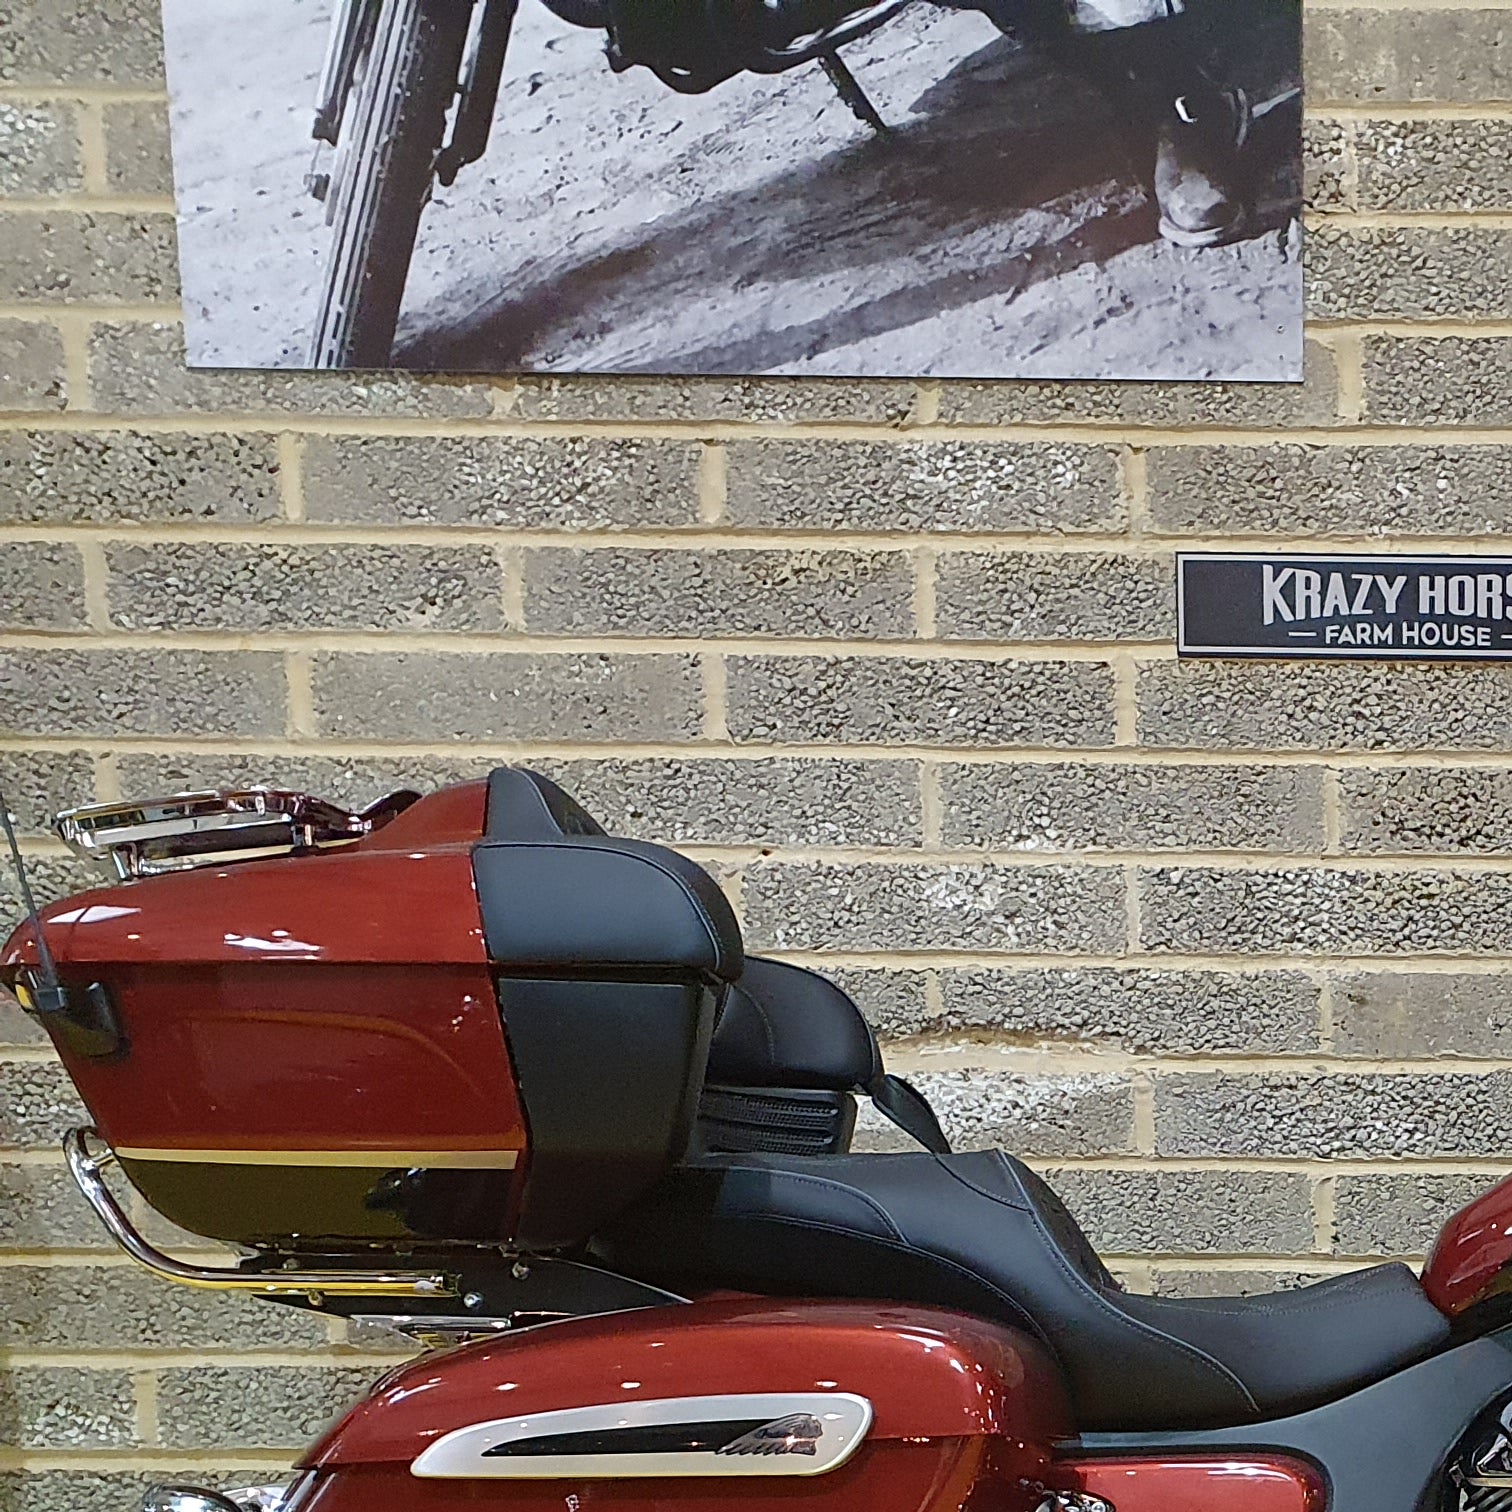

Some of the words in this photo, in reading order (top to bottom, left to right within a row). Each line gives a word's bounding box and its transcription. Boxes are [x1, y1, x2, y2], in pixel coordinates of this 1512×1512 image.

[1262, 564, 1408, 627] KRAZY
[1324, 623, 1393, 646] FARM
[1402, 621, 1492, 647] HOUSE
